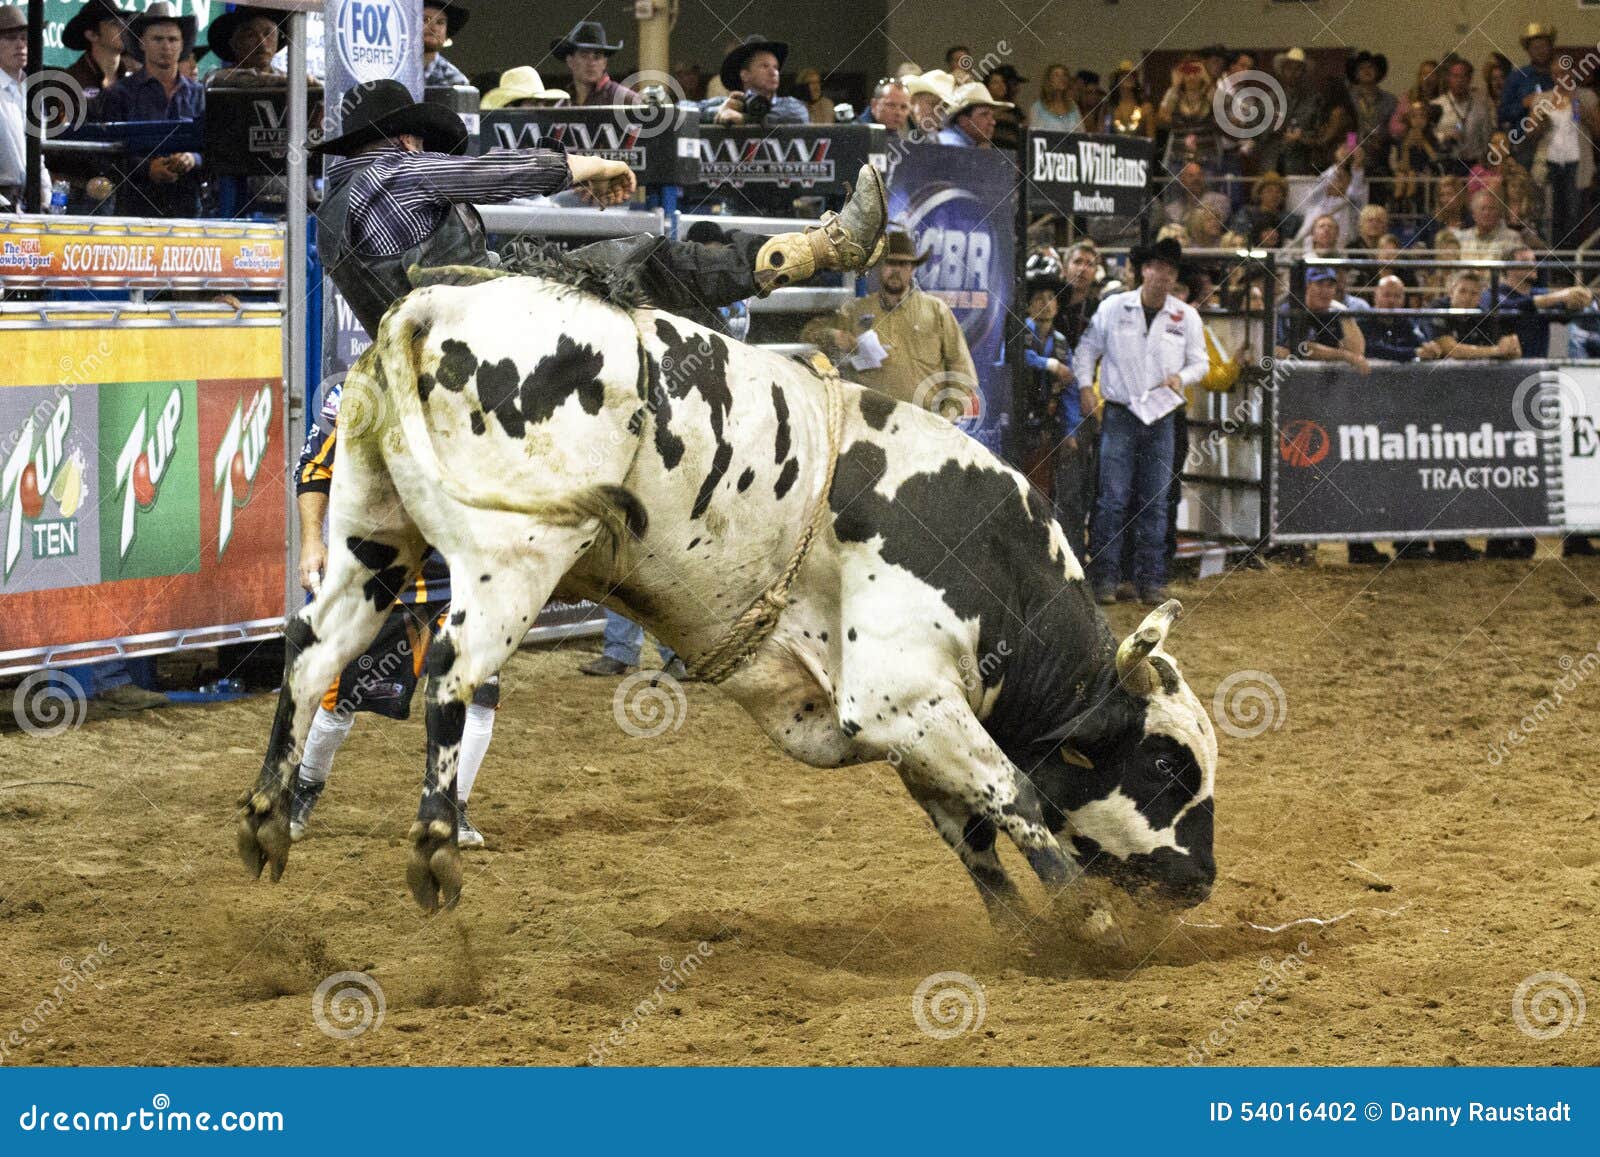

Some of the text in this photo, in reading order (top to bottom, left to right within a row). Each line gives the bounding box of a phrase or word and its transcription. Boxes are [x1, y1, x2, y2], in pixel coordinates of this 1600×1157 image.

[351, 2, 391, 46] FOX
[352, 47, 394, 65] SPORTS
[769, 163, 828, 173] SYSTEMS
[1033, 138, 1147, 187] Evan Williams
[1073, 190, 1114, 213] Bourbon
[5, 242, 19, 253] The
[241, 247, 253, 257] The
[0, 254, 50, 269] owboy Sport
[62, 244, 222, 276] SCOTTSDALE, ARIZONA
[234, 257, 280, 271] Cowboy Sport
[1338, 422, 1538, 461] Mahindra
[1419, 465, 1540, 490] TRACTORS
[33, 521, 76, 556] TEN
